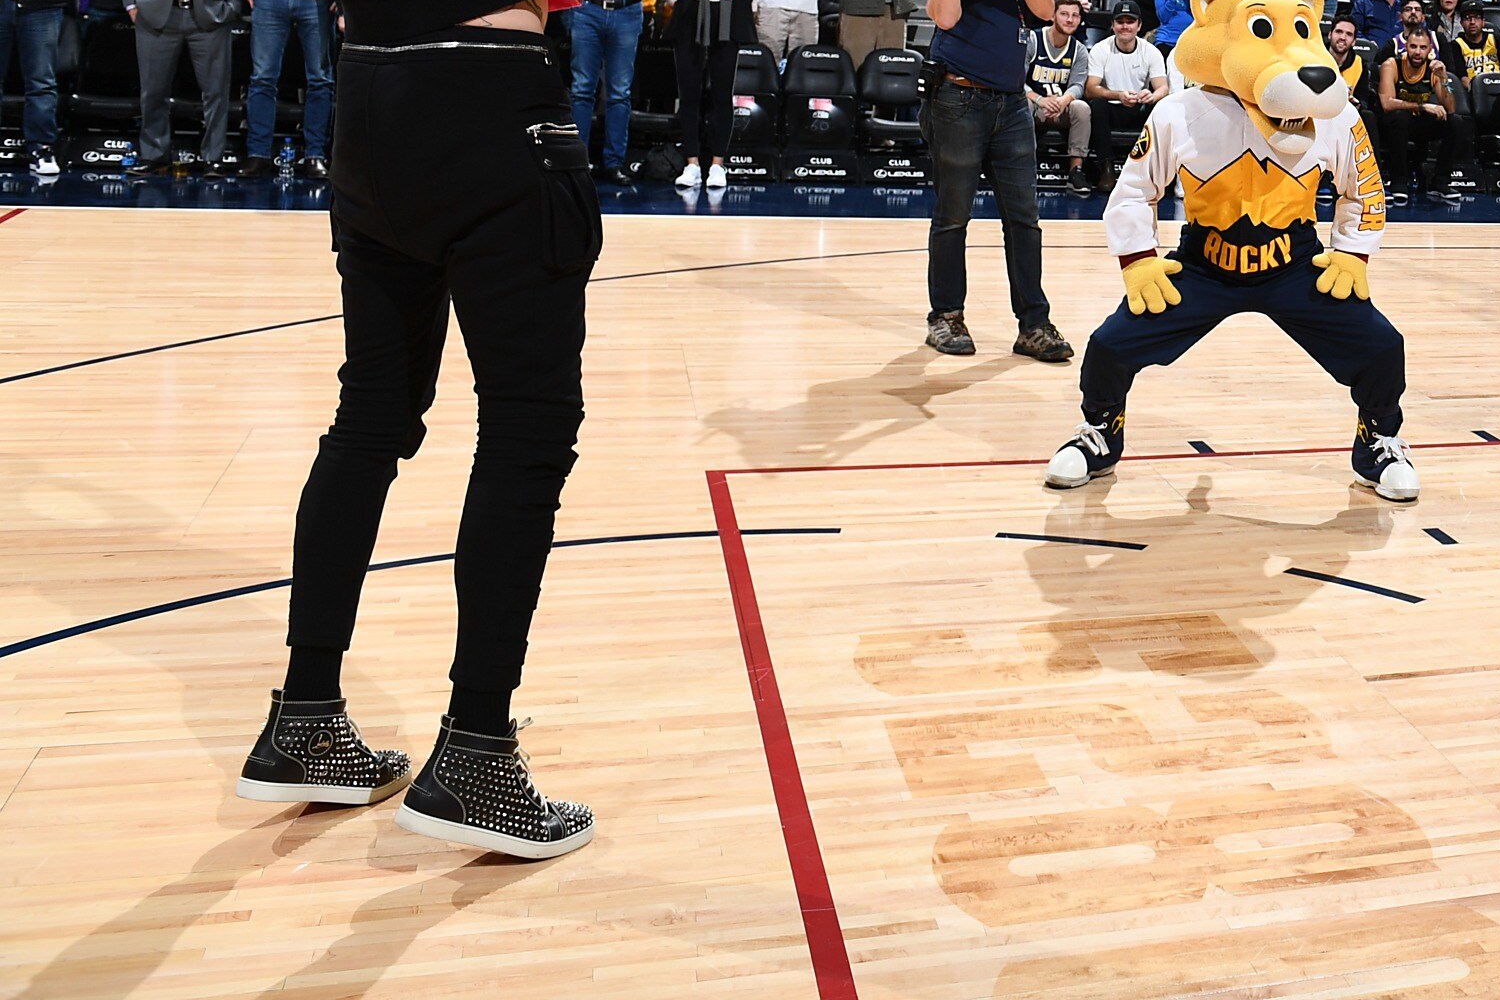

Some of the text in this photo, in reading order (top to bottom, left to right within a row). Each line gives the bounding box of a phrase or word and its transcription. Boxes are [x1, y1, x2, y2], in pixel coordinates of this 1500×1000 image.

[1032, 65, 1071, 84] DENVE
[1043, 84, 1063, 97] 15
[3, 138, 25, 147] CLU
[730, 156, 753, 164] CLUB
[810, 157, 833, 165] CLUB
[889, 159, 911, 167] CLUB
[728, 167, 767, 176] LEXUS
[808, 168, 847, 176] LEXUS
[887, 170, 925, 178] LEXUS
[1351, 117, 1386, 232] DENVER
[1203, 229, 1292, 274] ROCKY
